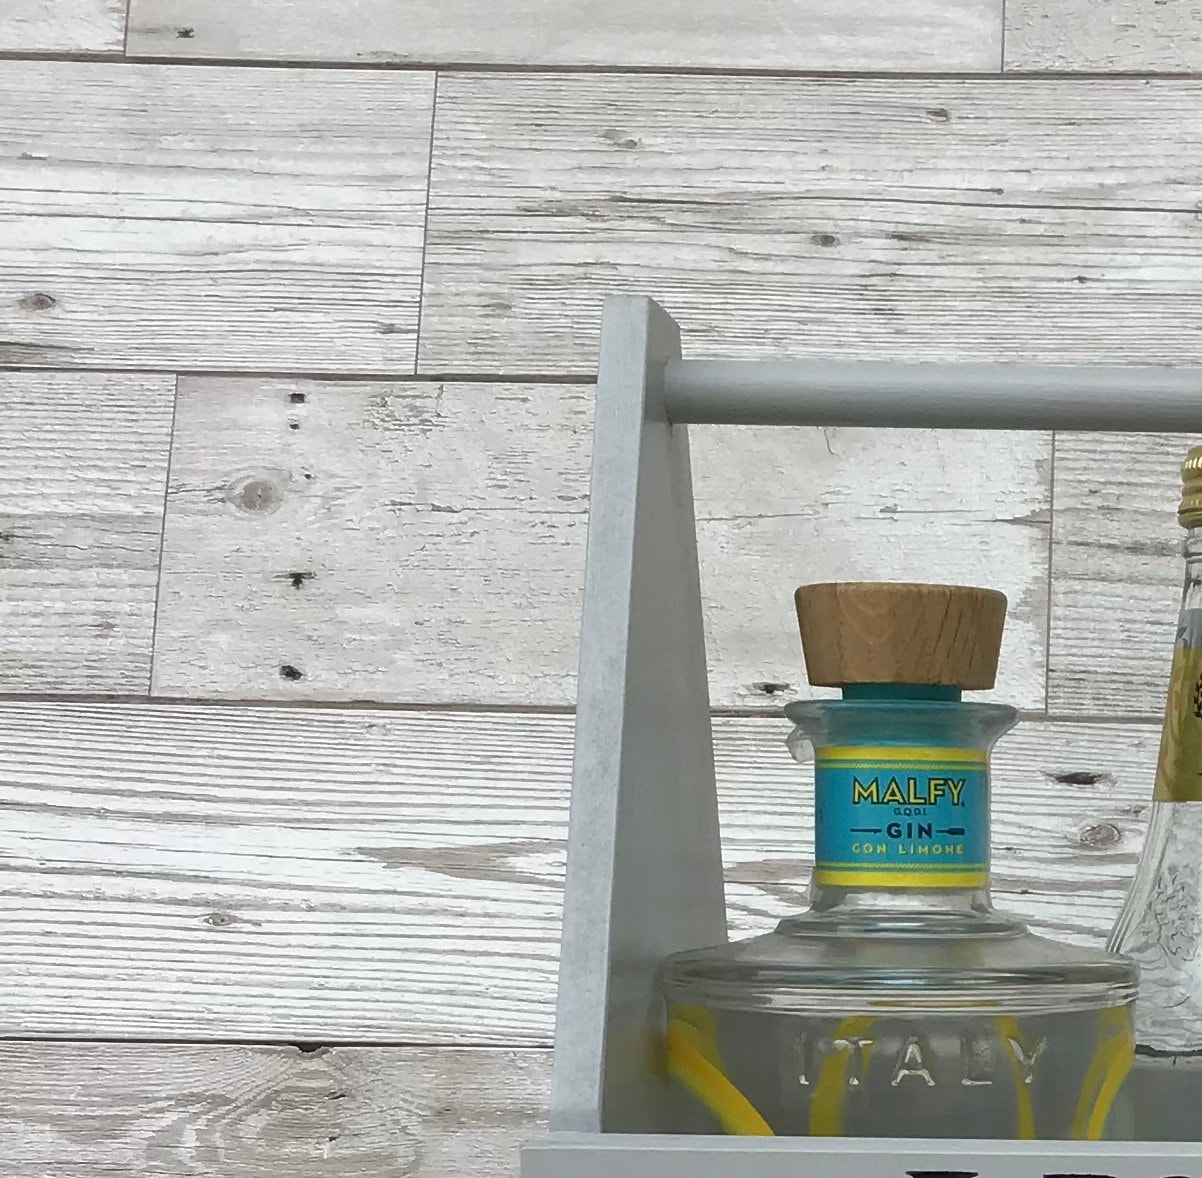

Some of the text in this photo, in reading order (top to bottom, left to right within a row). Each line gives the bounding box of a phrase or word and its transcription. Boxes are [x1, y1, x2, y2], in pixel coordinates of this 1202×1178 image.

[852, 775, 966, 806] MALFY
[886, 822, 933, 839] GIN
[852, 843, 965, 856] CON LIMONE
[797, 1033, 1047, 1087] ITALY
